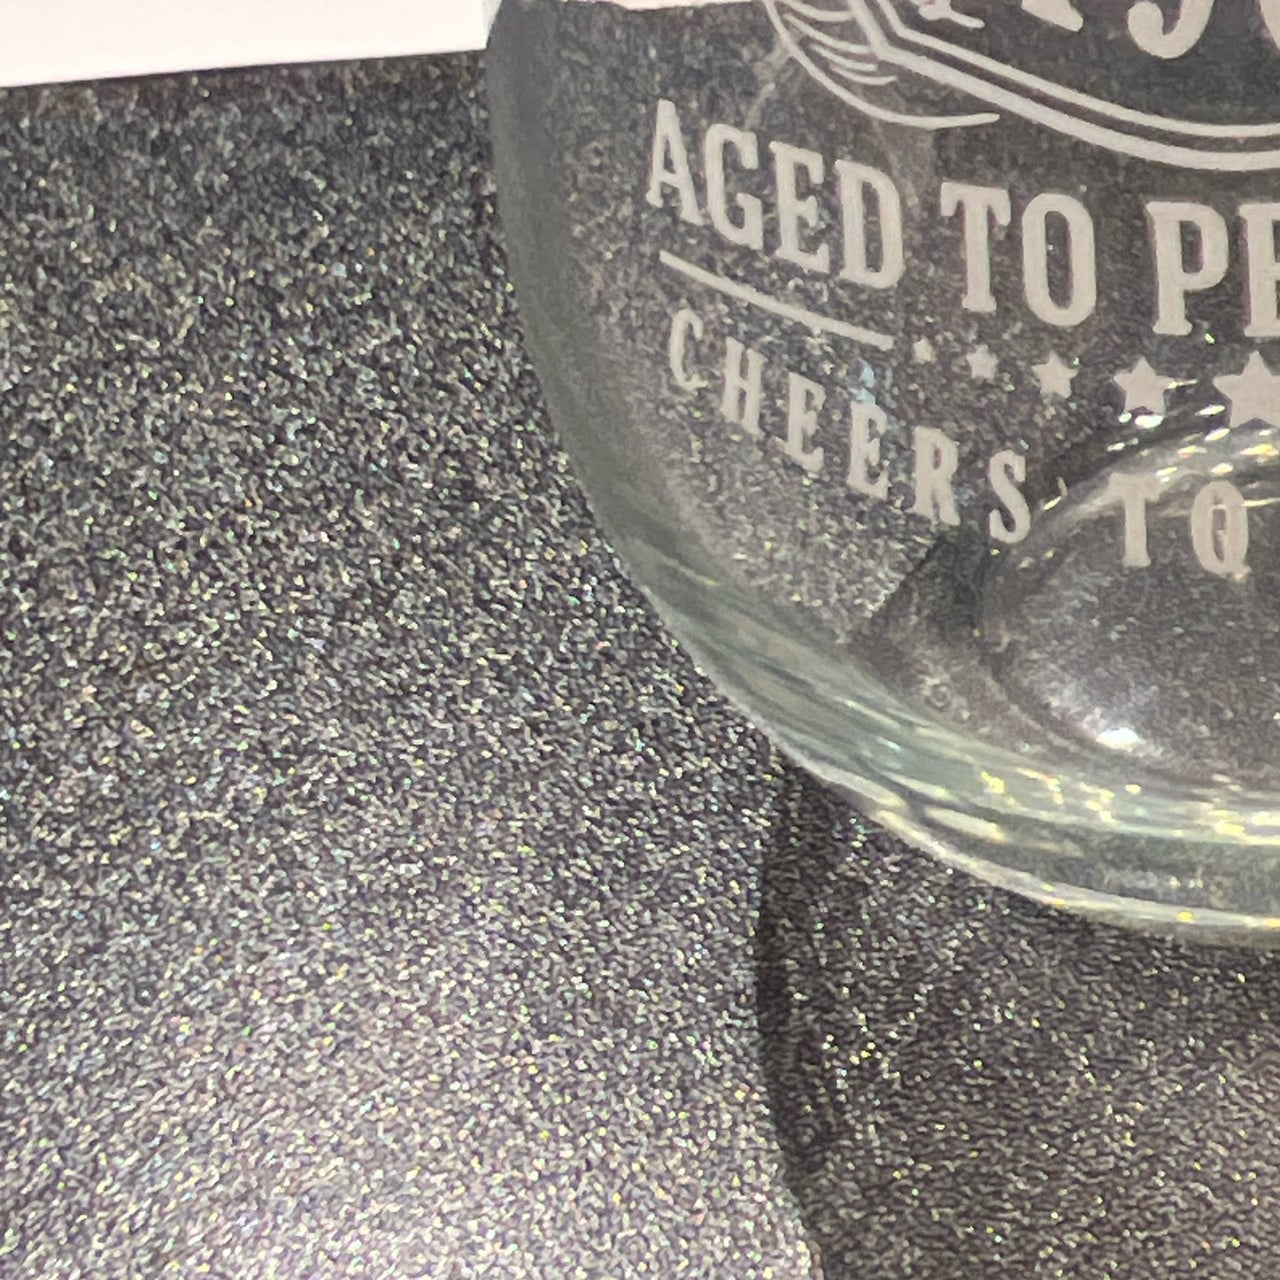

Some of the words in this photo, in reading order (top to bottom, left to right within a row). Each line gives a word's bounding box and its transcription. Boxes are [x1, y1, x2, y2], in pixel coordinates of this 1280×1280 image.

[646, 98, 902, 289] AGED
[940, 181, 1098, 327] TO
[669, 307, 1052, 545] CHEERS
[1106, 471, 1251, 576] TO
